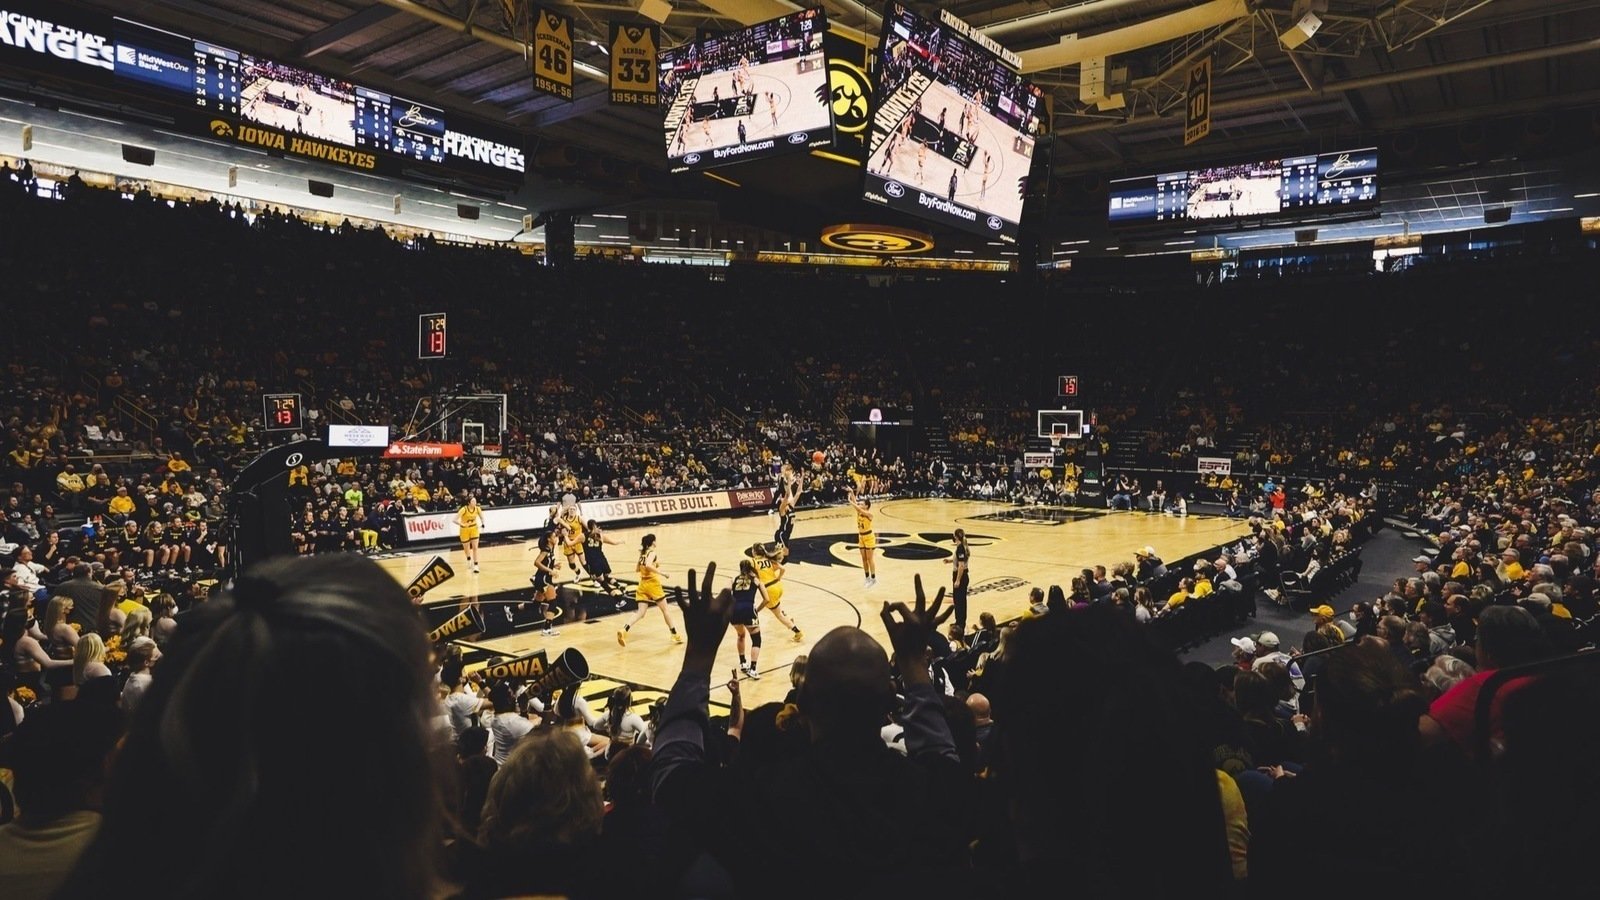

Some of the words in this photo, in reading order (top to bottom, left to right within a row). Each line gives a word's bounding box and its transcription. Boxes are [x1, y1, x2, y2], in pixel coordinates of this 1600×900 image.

[138, 53, 189, 72] MidWestOne
[540, 44, 567, 75] 46
[618, 58, 650, 84] 33
[535, 78, 572, 98] 1954-56
[612, 92, 657, 105] 1954-56
[1190, 92, 1204, 120] 10
[238, 125, 285, 150] IOWA
[290, 138, 376, 169] HAWKEYES
[713, 140, 774, 159] BuyFordNow.com
[918, 192, 977, 222] BuyFordNow.com
[431, 332, 442, 352] 13
[1065, 384, 1075, 394] 13
[274, 399, 294, 409] 7:29
[278, 410, 291, 424] 13
[402, 445, 442, 455] StateFarm
[1200, 461, 1229, 471] ESPN
[627, 499, 678, 515] BETTER
[681, 496, 718, 510] BUILT.
[757, 560, 771, 569] 20
[408, 564, 450, 597] OWA
[430, 613, 472, 642] OWA
[484, 657, 544, 678] IOWA
